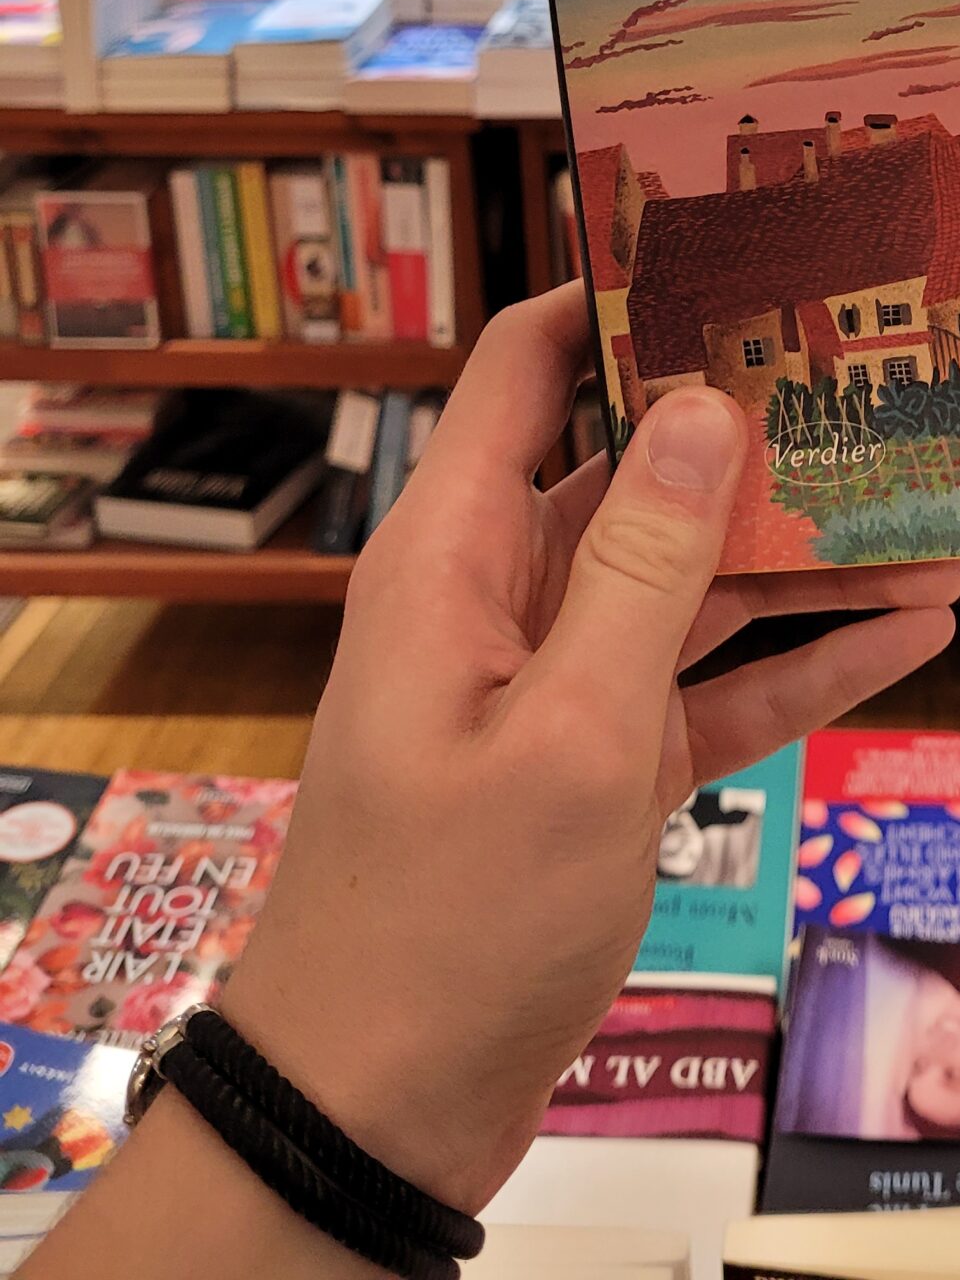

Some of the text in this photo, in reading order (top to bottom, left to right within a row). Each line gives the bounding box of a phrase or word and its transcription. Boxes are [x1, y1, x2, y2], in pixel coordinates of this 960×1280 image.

[770, 431, 882, 470] Verdier
[104, 852, 259, 889] EN FEU
[105, 884, 219, 918] TOUT
[81, 950, 183, 985] L'AIR
[606, 1055, 660, 1090] AL
[671, 1055, 758, 1091] ABD
[869, 1170, 951, 1204] Tunis
